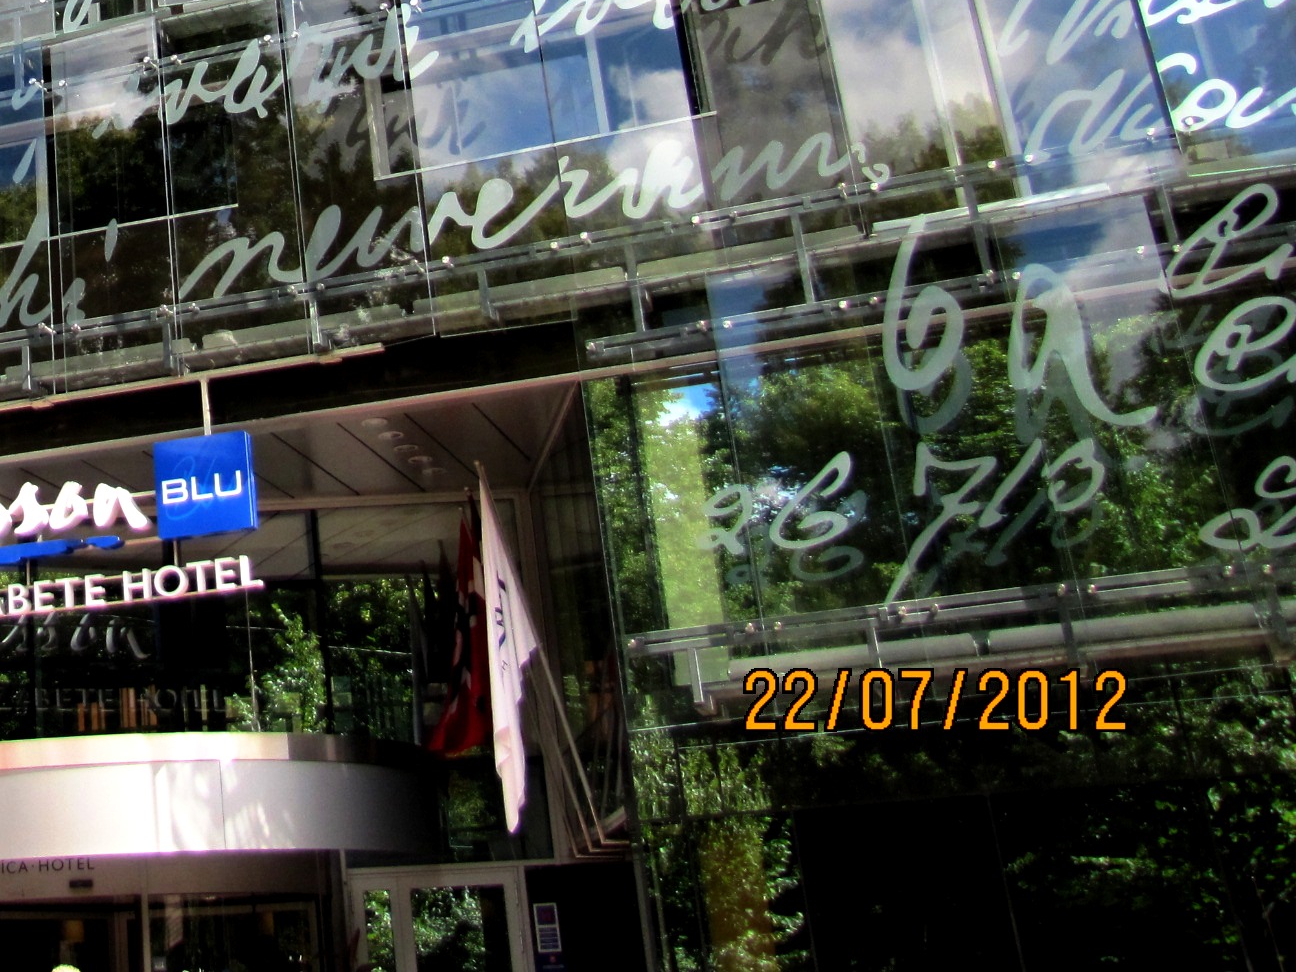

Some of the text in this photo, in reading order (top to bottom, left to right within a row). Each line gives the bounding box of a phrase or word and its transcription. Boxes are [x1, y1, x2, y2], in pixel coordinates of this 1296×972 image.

[160, 469, 244, 506] BLU
[122, 555, 265, 603] HOTEL
[38, 857, 95, 872] HOTEL
